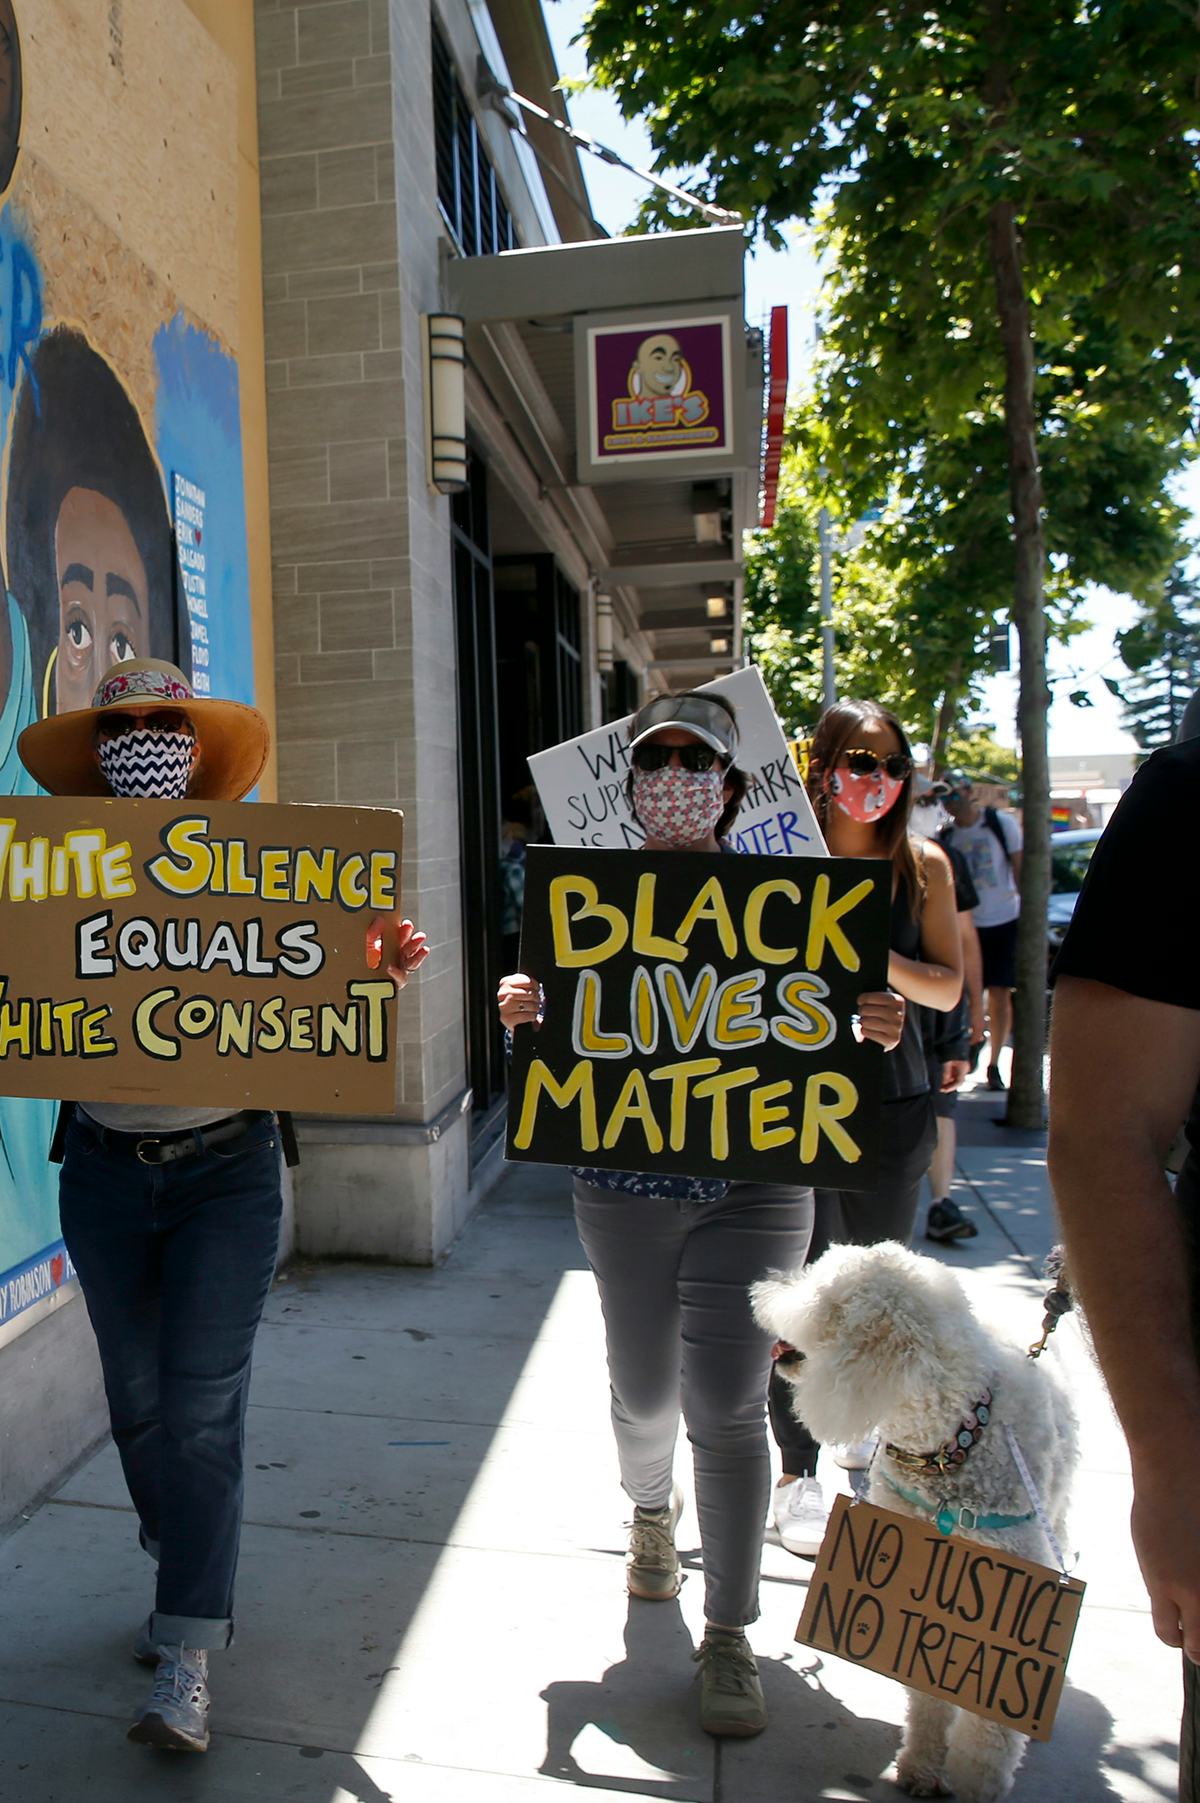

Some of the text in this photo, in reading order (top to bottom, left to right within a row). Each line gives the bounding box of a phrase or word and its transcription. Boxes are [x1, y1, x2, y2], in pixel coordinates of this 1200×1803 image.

[614, 394, 708, 428] IKE'S
[144, 815, 397, 912] SILENCE
[76, 910, 326, 979] EQUALS
[550, 872, 875, 973] BLACK
[133, 979, 398, 1062] CONSENT
[572, 963, 837, 1059] LIVES
[514, 1057, 862, 1164] MATTER
[8, 1261, 52, 1312] ROBINSON
[828, 1510, 903, 1589] NO
[807, 1582, 1056, 1730] NO TREATS!
